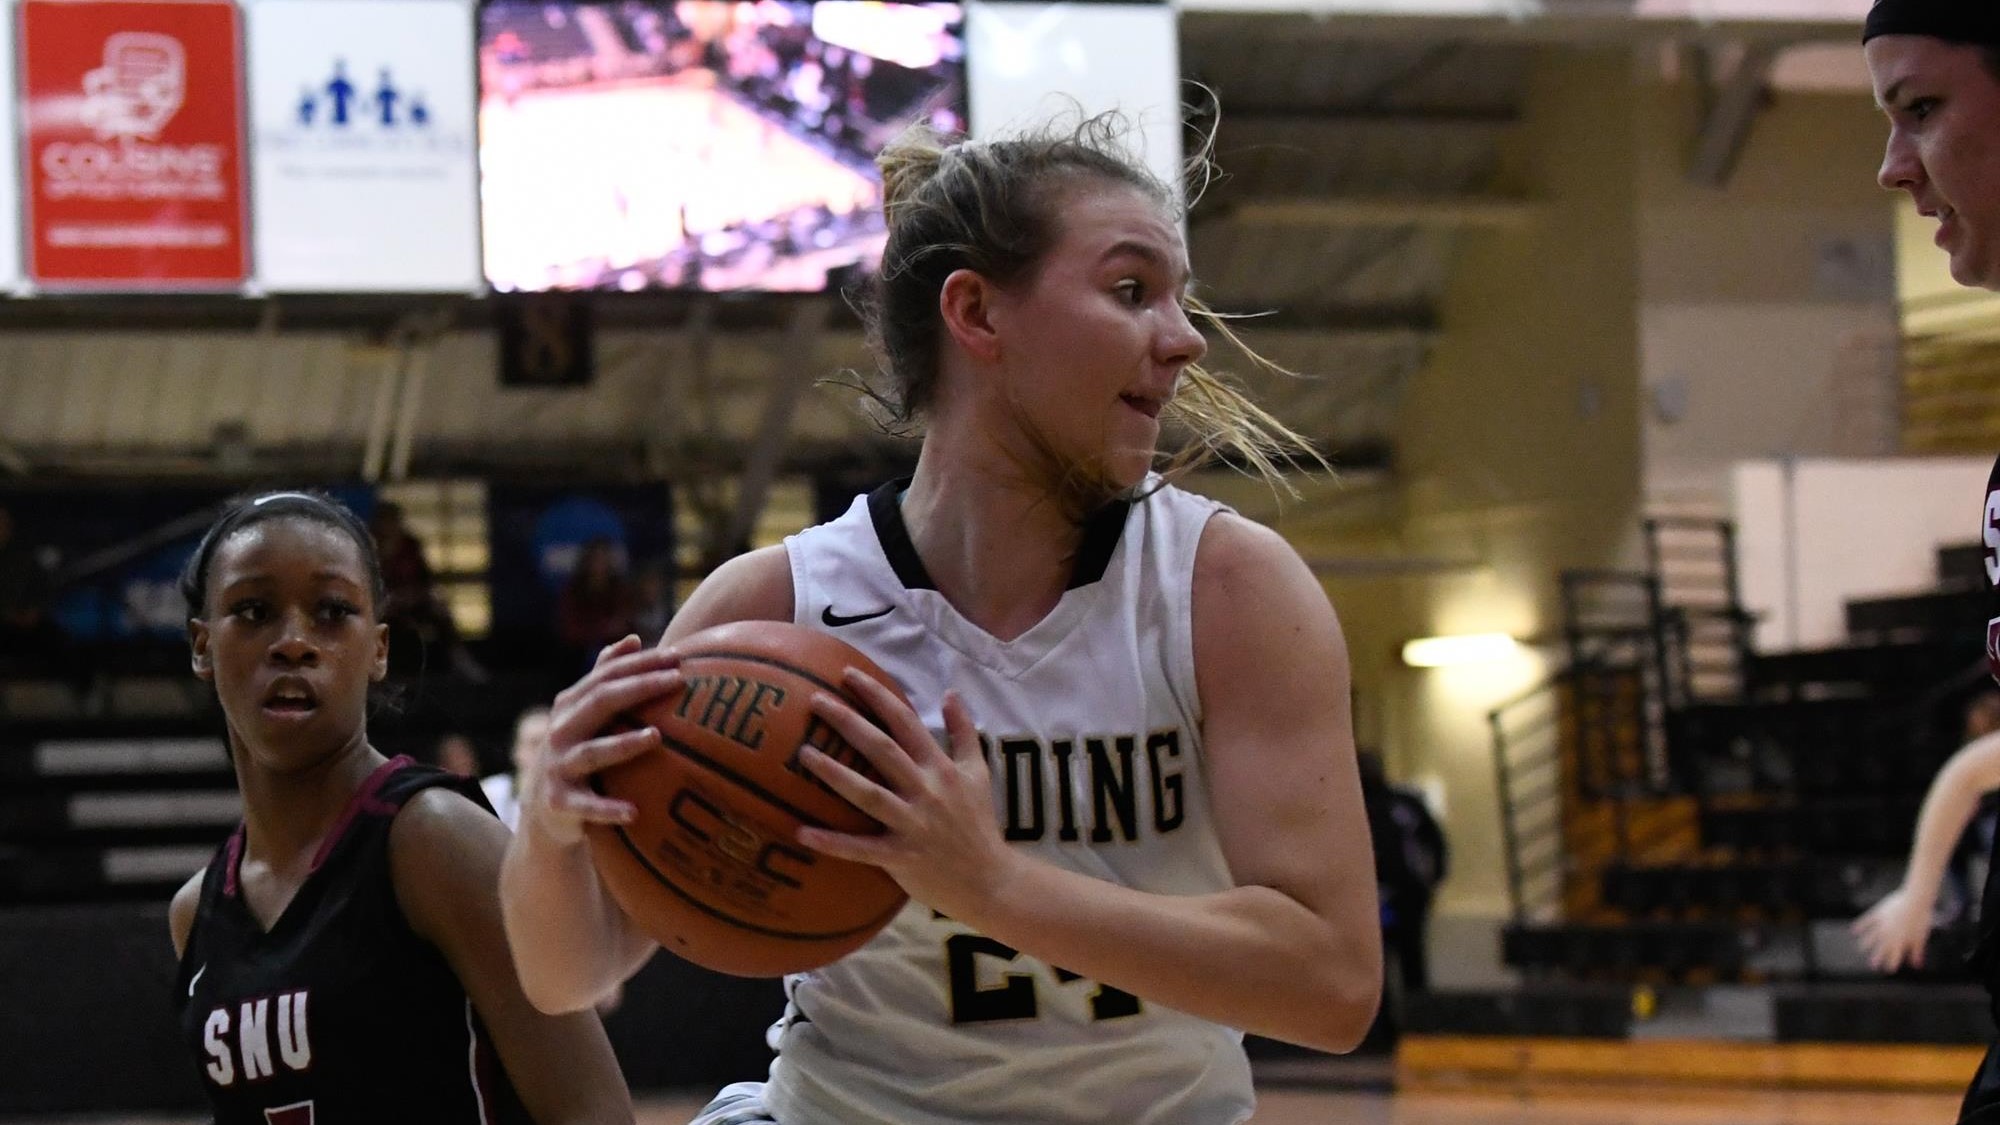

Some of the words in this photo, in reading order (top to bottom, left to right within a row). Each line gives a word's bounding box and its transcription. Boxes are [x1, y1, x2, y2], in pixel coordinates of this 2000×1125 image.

[675, 675, 785, 749] THE
[978, 727, 1184, 842] DING
[204, 991, 312, 1086] SNU
